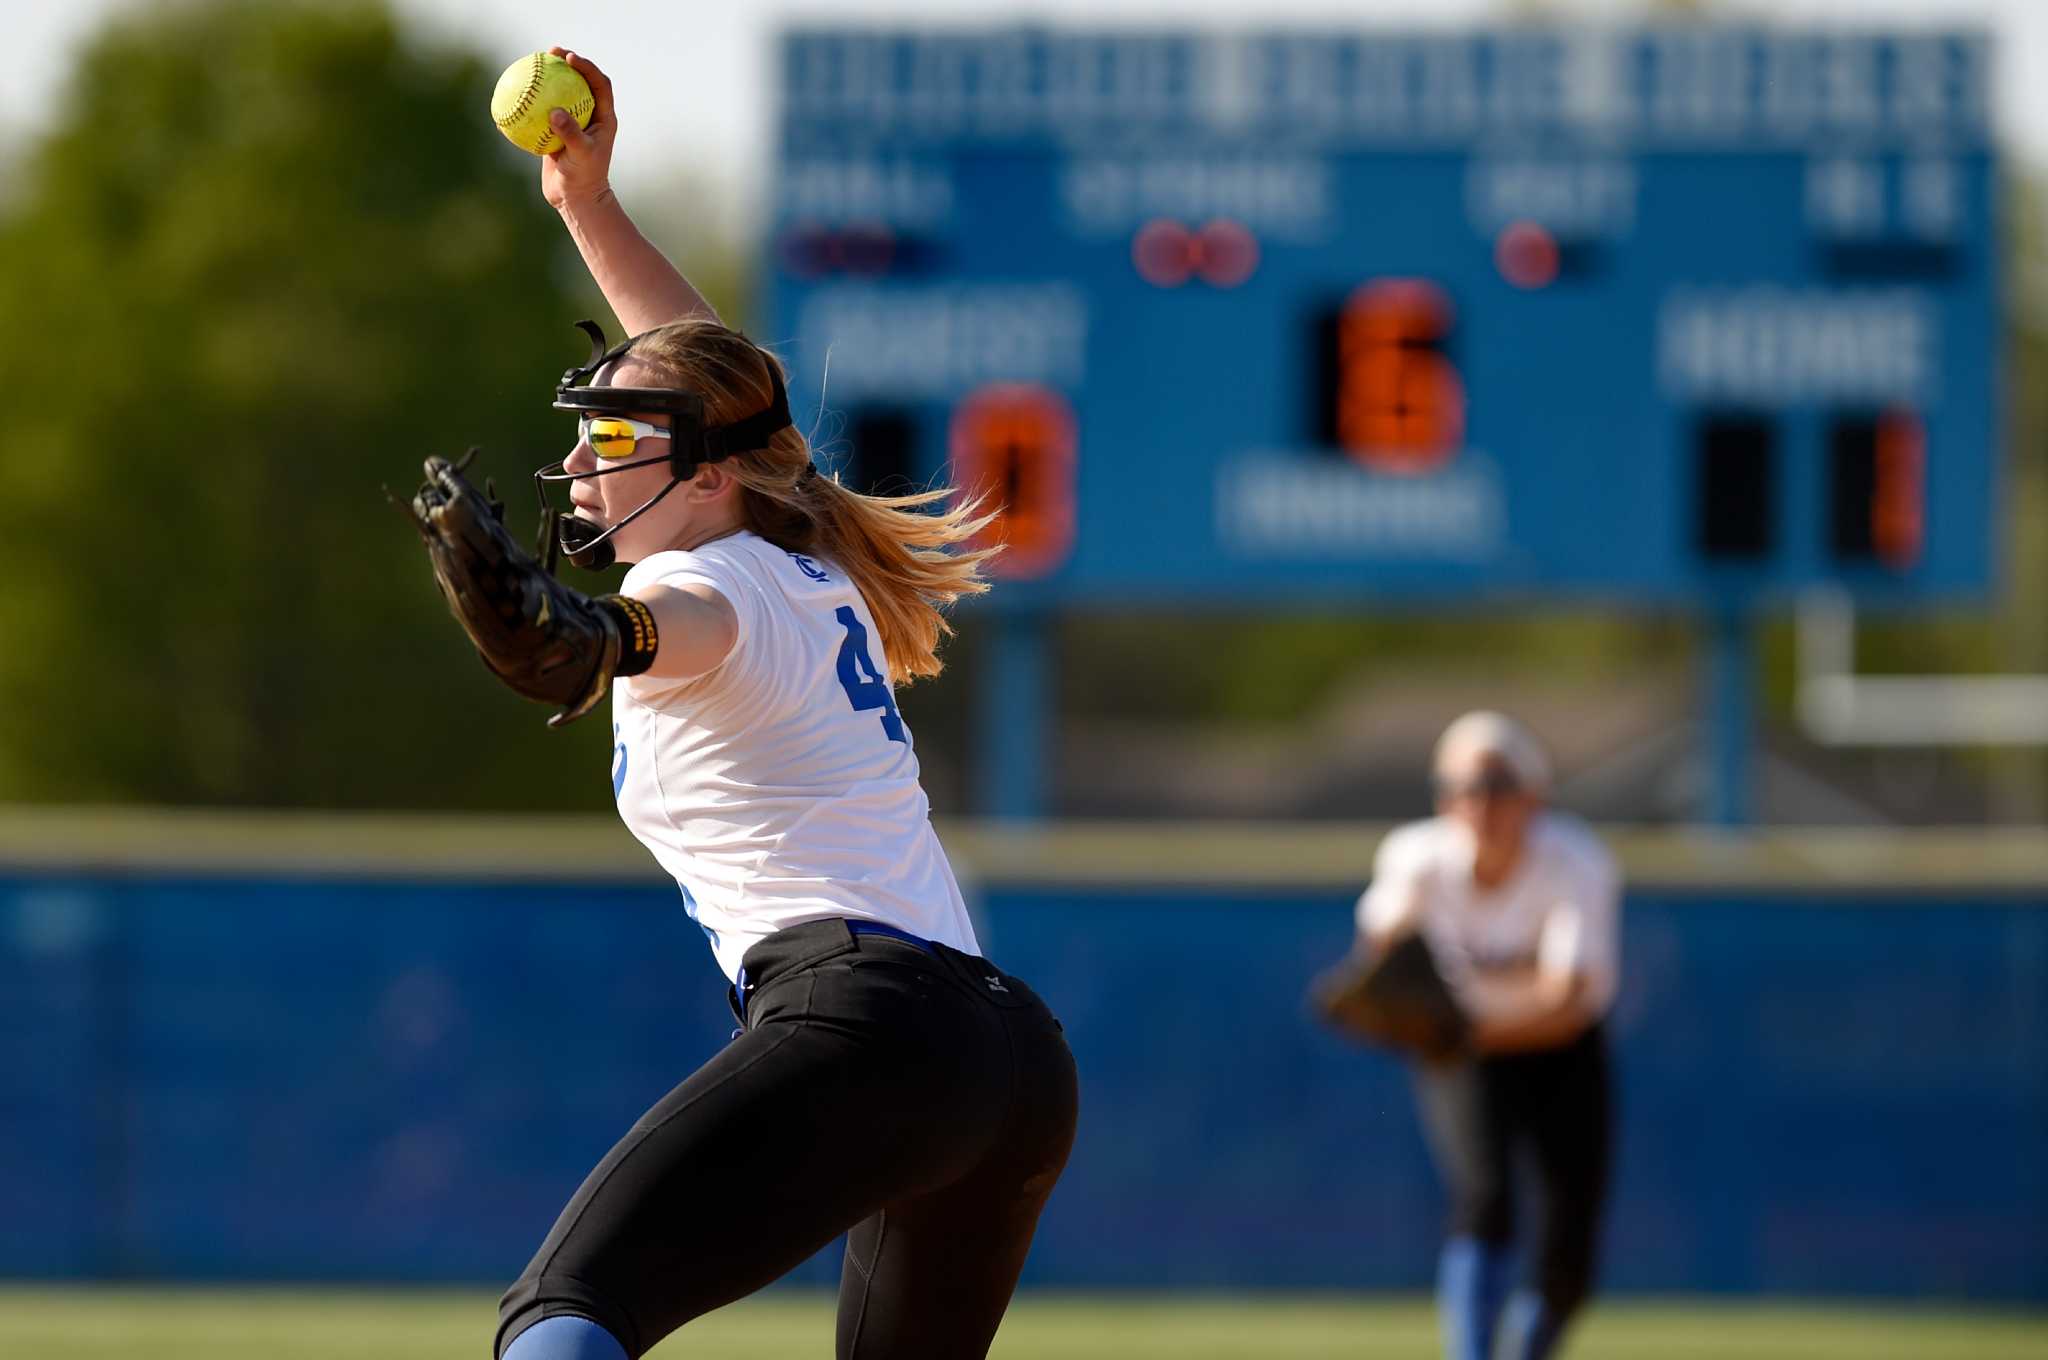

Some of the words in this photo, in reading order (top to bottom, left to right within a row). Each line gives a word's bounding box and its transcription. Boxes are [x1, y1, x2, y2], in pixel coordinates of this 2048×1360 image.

[1338, 278, 1465, 474] 6
[950, 384, 1078, 580] 0
[1871, 404, 1928, 574] 1
[835, 604, 910, 744] 4
